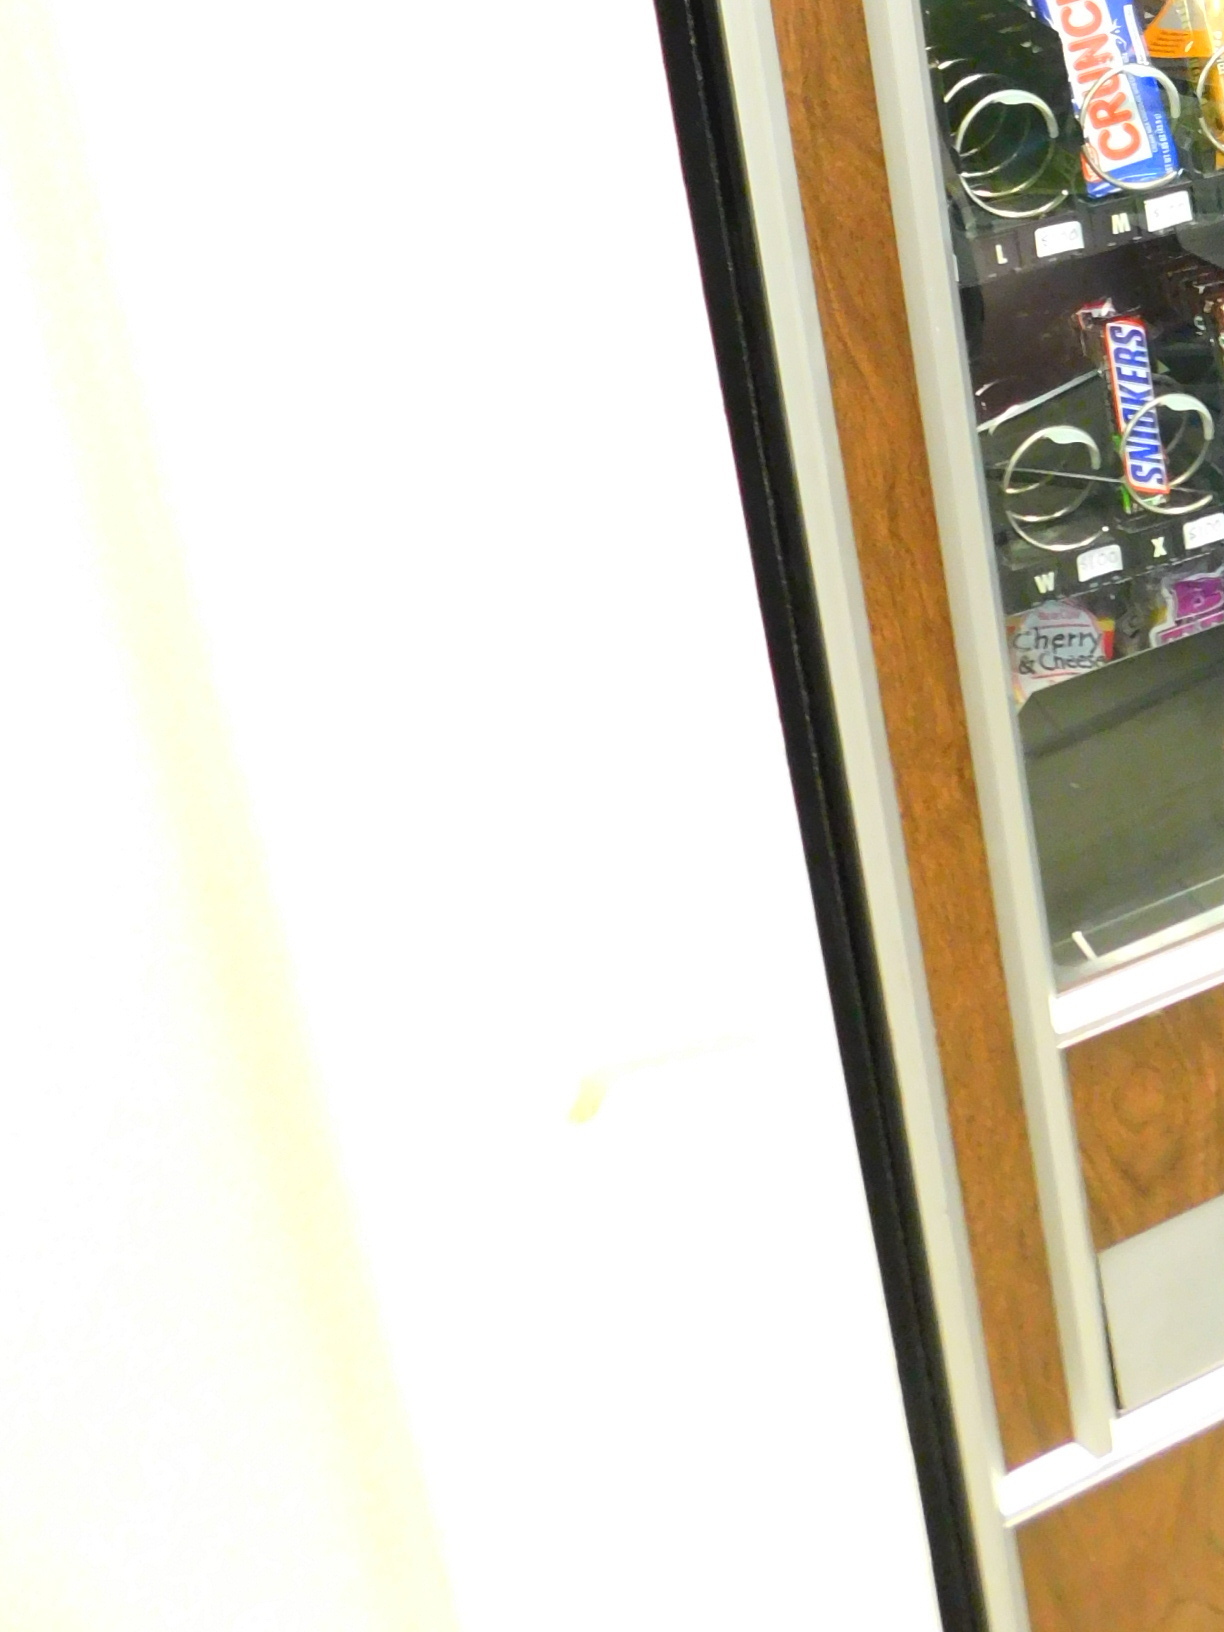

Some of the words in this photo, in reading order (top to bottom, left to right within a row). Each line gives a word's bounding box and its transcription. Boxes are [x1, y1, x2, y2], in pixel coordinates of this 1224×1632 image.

[1110, 212, 1132, 235] M
[995, 243, 1009, 265] L
[1109, 325, 1165, 485] SNICKERS
[1150, 536, 1167, 558] X
[1033, 571, 1056, 594] W
[1012, 626, 1099, 655] Cherry
[1018, 656, 1035, 674] &
